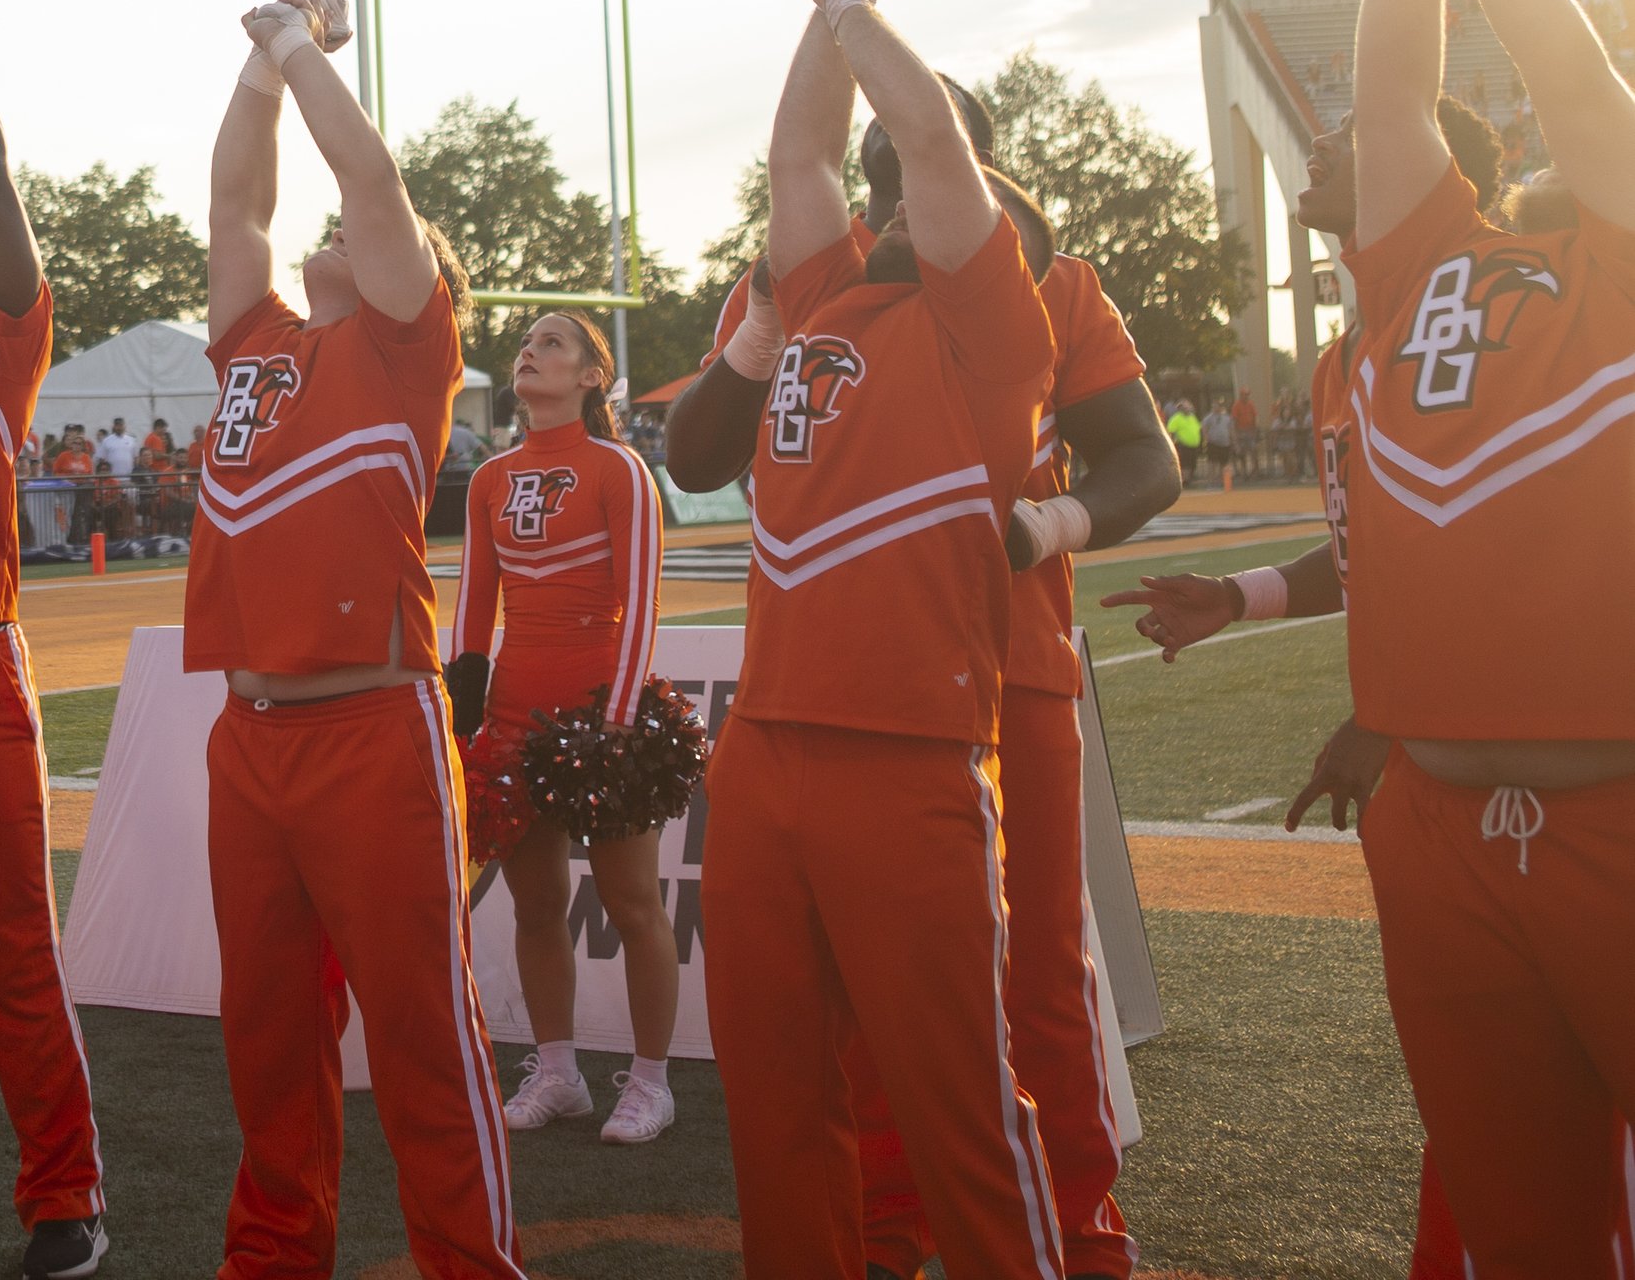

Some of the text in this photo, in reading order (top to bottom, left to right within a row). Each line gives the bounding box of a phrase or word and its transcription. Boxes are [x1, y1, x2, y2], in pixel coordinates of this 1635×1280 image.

[1400, 256, 1483, 408] BG
[216, 365, 257, 456] BG
[770, 344, 809, 452] BG
[507, 474, 545, 535] BG
